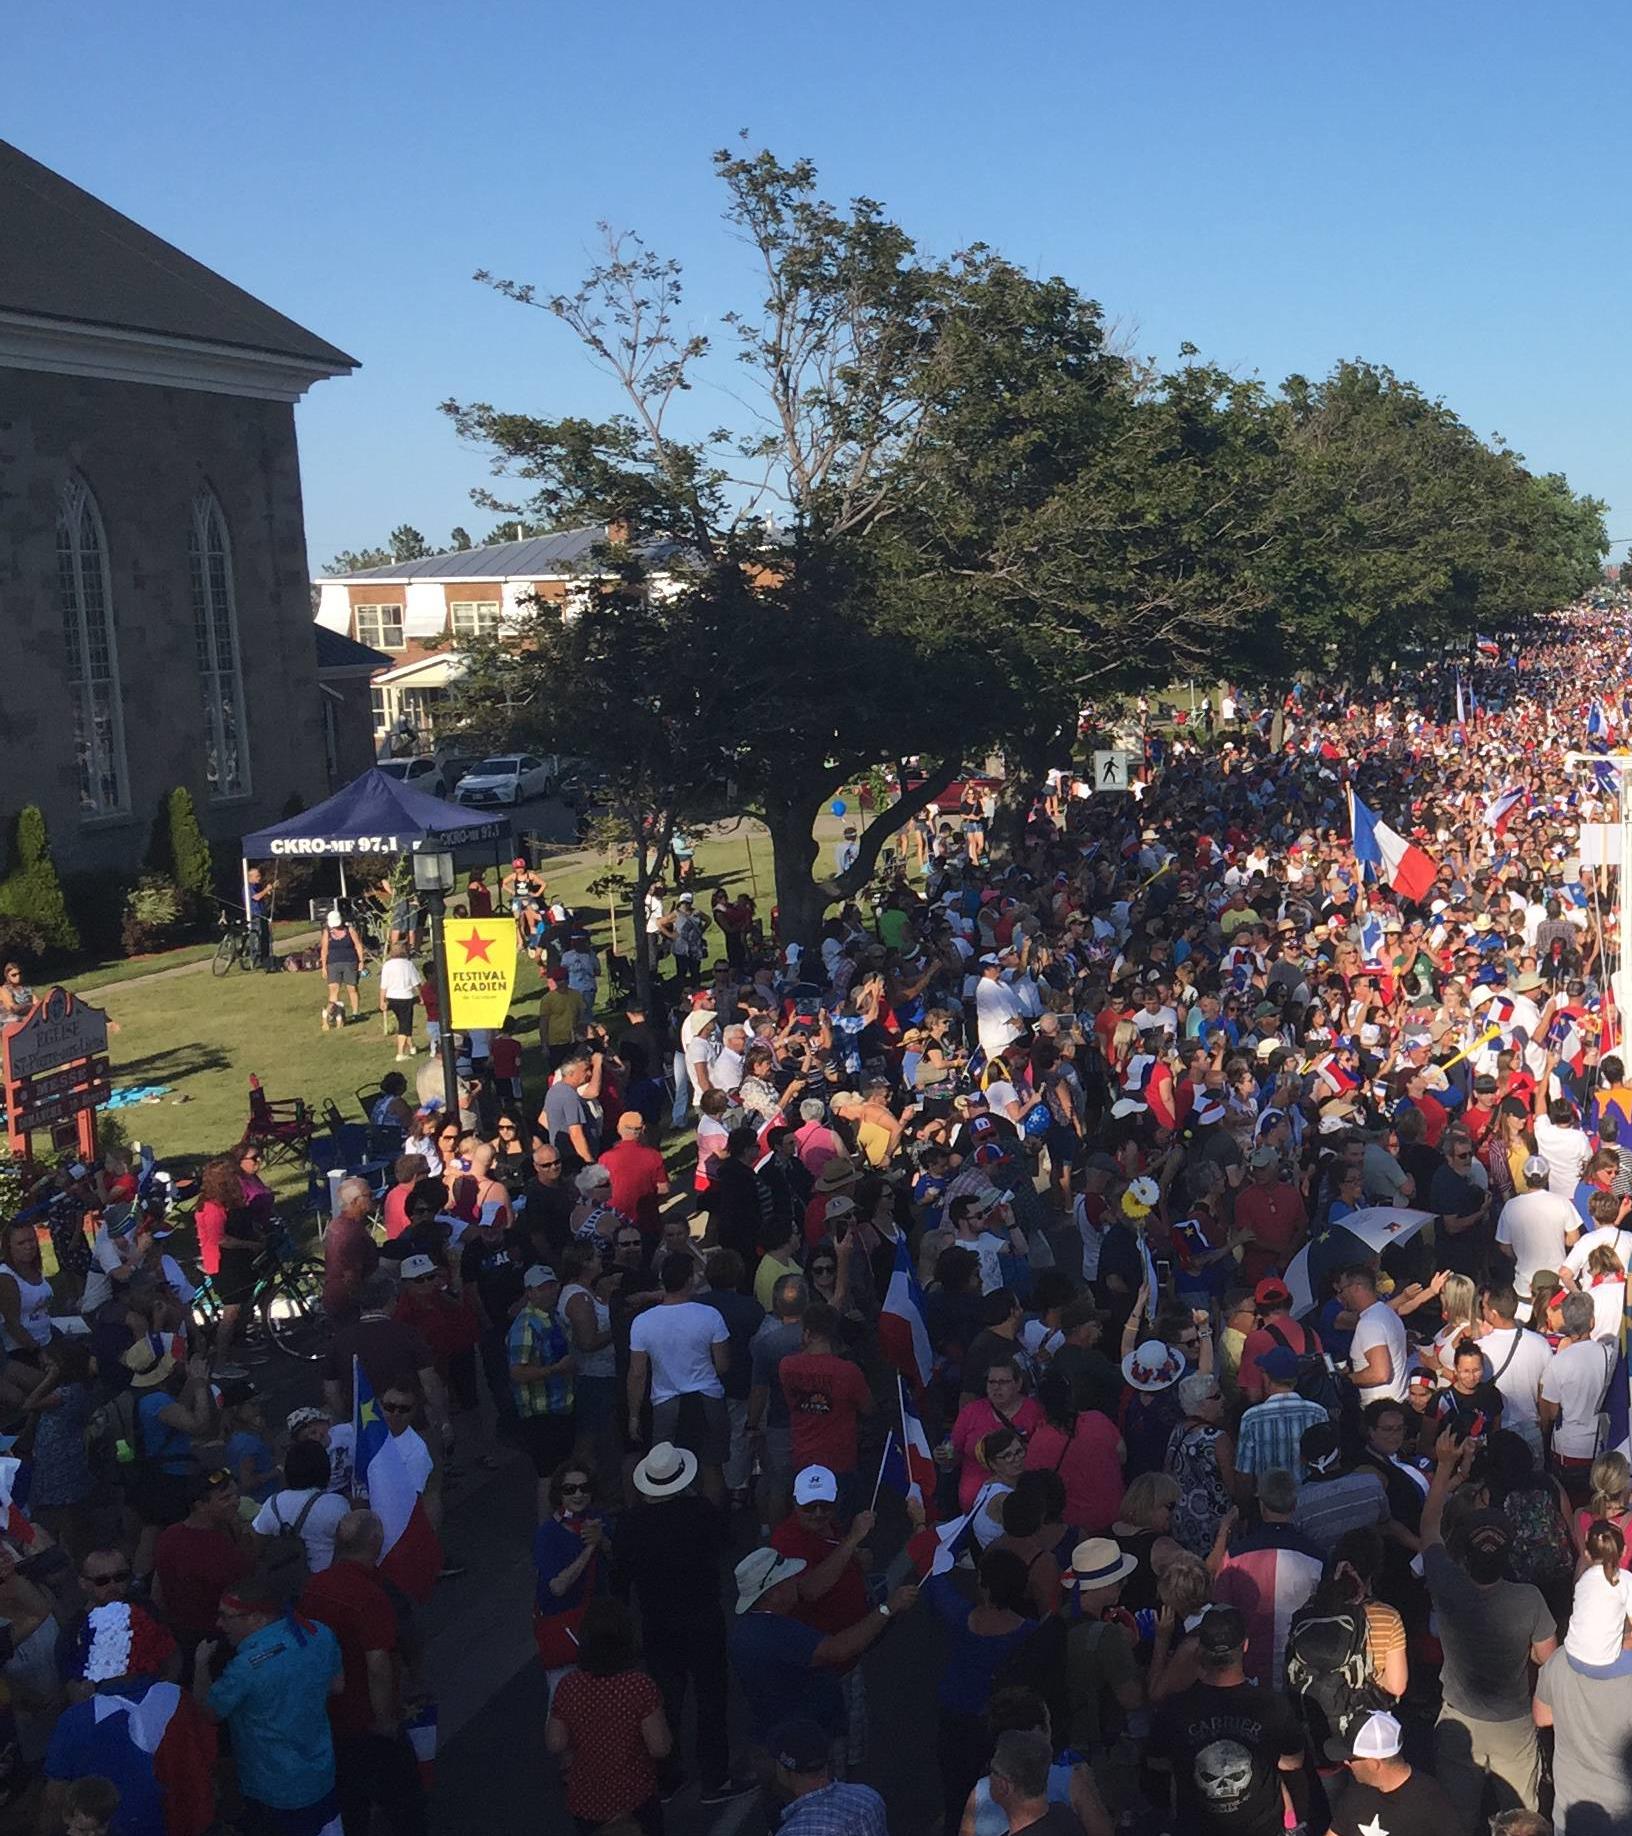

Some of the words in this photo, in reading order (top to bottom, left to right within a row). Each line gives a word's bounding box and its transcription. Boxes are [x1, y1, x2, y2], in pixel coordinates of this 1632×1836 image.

[358, 836, 398, 855] 97,1
[452, 971, 506, 982] FESTIVAL
[453, 982, 507, 994] ACADIEN
